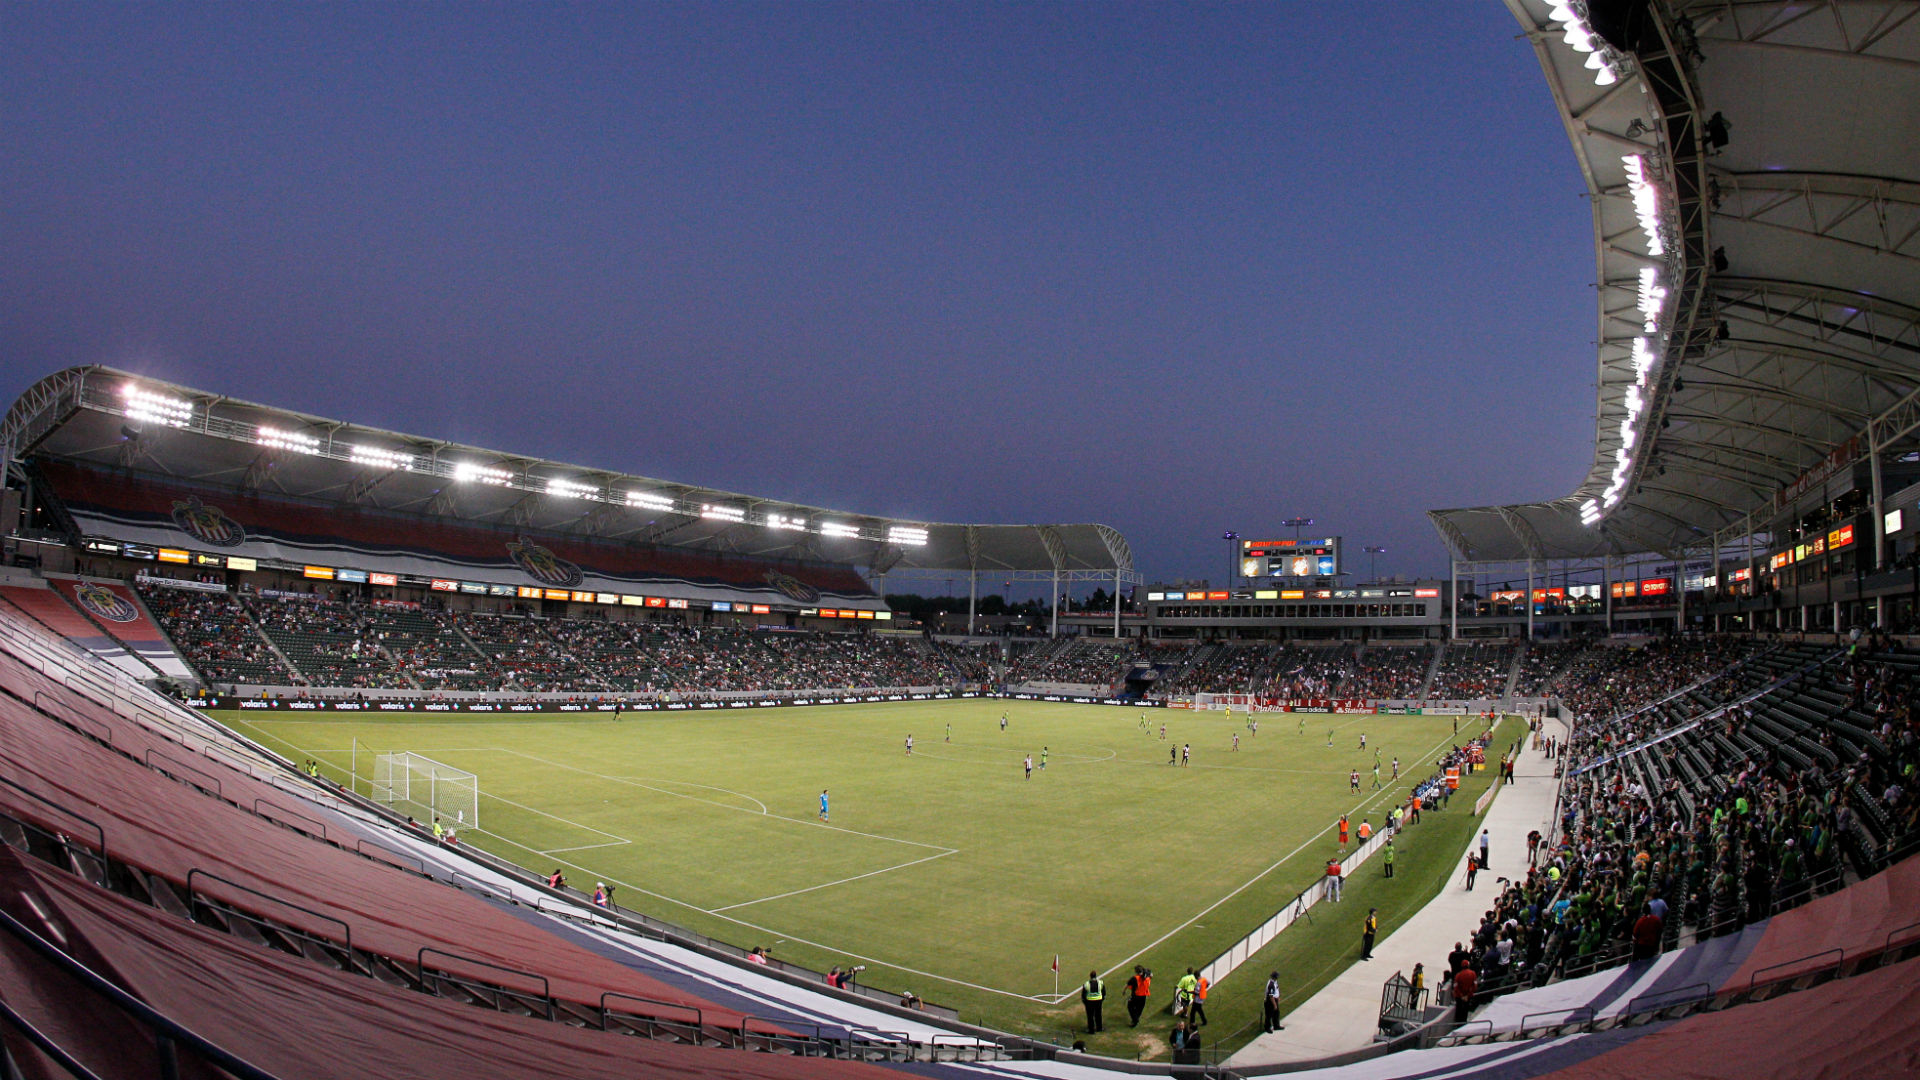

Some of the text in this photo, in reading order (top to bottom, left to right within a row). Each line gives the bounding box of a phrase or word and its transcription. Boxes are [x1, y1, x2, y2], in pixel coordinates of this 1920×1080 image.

[240, 699, 268, 708] volaris
[289, 700, 316, 709] volaris
[335, 701, 360, 710] volaris
[380, 702, 405, 710] volaris
[424, 702, 449, 711] volaris
[469, 703, 493, 711] volaris
[510, 703, 534, 711] volaris
[560, 703, 581, 711] volaris
[632, 702, 653, 710] volaris
